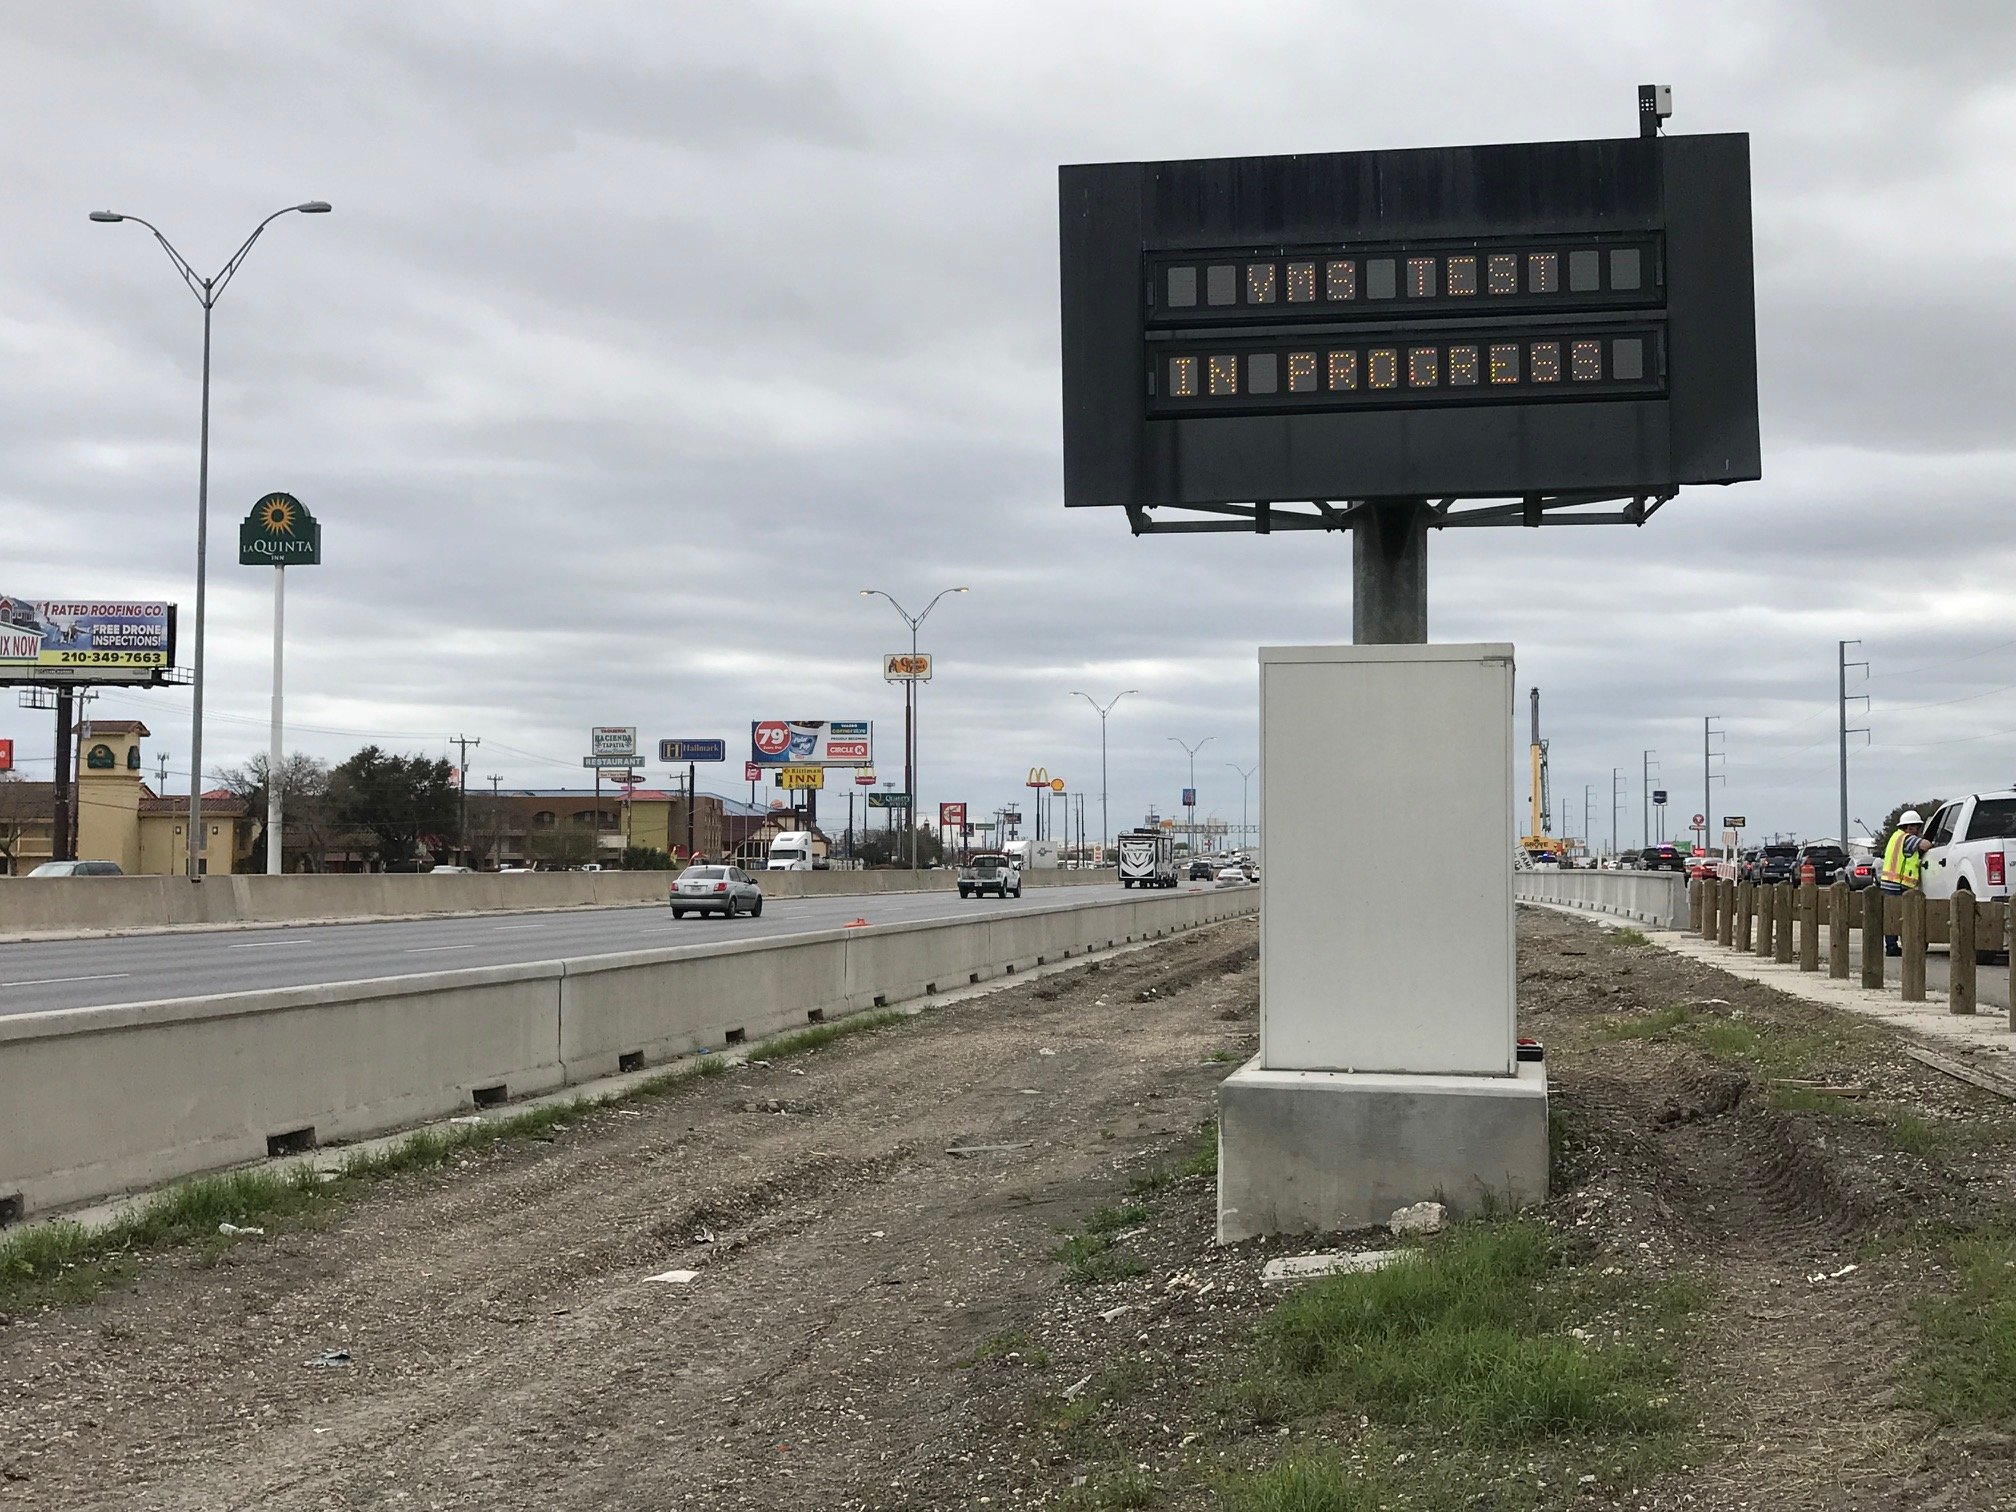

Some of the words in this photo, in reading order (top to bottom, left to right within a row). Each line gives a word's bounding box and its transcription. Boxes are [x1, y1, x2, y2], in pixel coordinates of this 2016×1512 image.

[1248, 263, 1354, 302] VMS
[1408, 256, 1556, 295] TEST
[1176, 356, 1237, 395] IN
[1289, 344, 1599, 391] PROGRESS
[254, 539, 313, 555] QUINTA
[51, 604, 88, 615] RATED
[91, 604, 141, 615] ROOFING
[145, 605, 164, 616] CO.
[93, 624, 120, 635] FREE
[122, 624, 161, 635] DRONE
[13, 636, 38, 656] NOW
[92, 635, 161, 646] INSPECTIONS!
[61, 652, 161, 663] 210-349-7663
[683, 743, 720, 752] Hallmark
[829, 746, 854, 754] CIRCLE
[585, 758, 642, 766] RESTAURANT
[789, 774, 817, 783] INN
